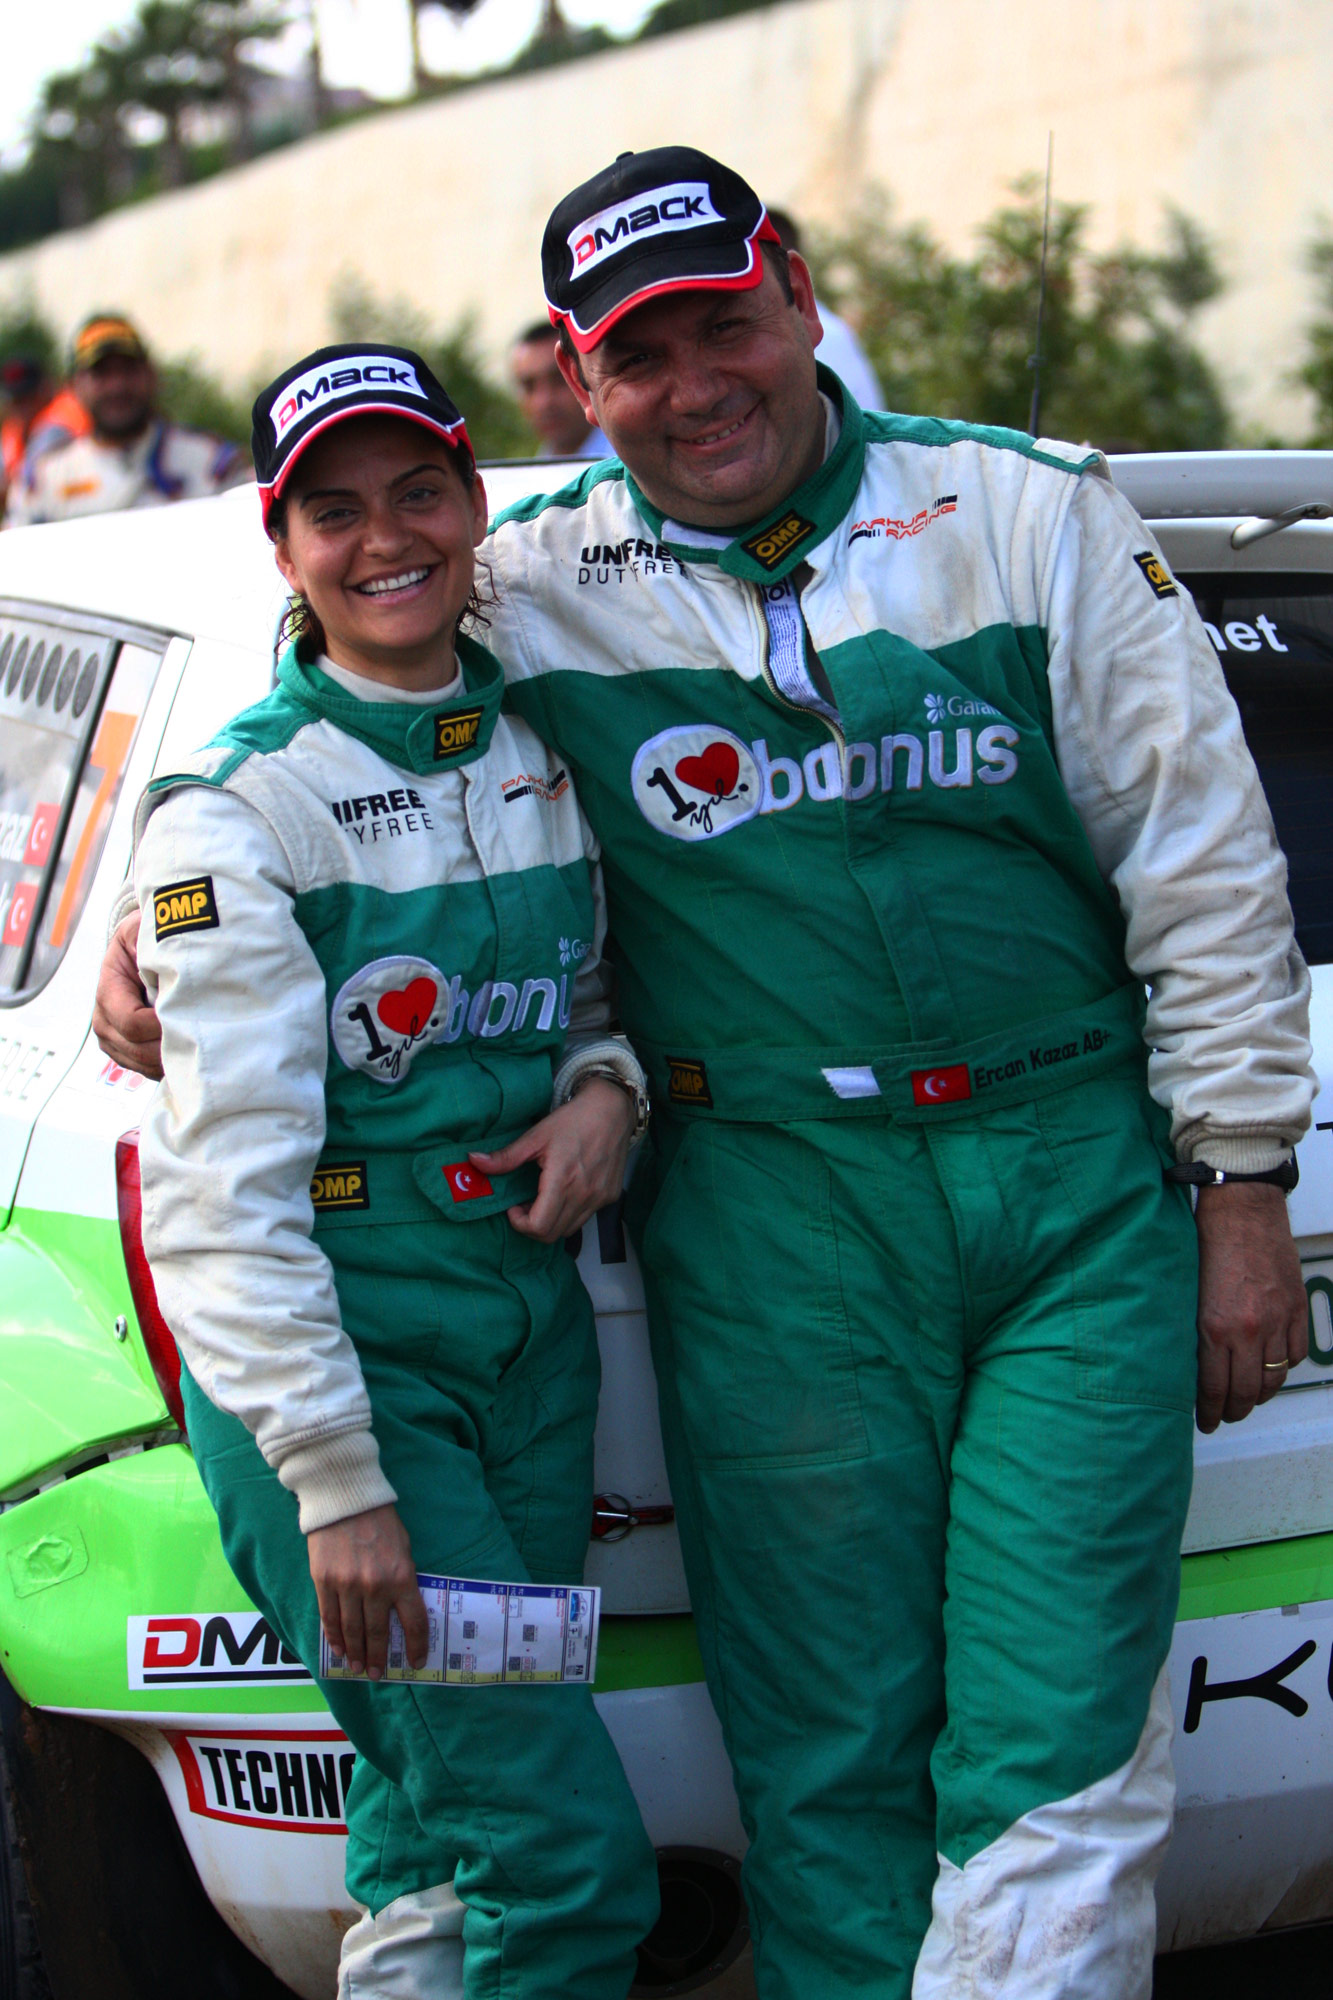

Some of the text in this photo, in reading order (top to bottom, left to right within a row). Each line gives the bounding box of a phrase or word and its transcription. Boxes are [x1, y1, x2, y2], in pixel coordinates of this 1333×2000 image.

[756, 518, 802, 558] OMP
[886, 504, 957, 540] RACING
[440, 719, 479, 749] OMP
[156, 892, 208, 925] OMP
[973, 1028, 1111, 1089] Ercan Kazaz AB+
[672, 1070, 703, 1095] OMP
[309, 1174, 362, 1199] OMP
[143, 1616, 303, 1668] DM
[1183, 1639, 1333, 1734] K
